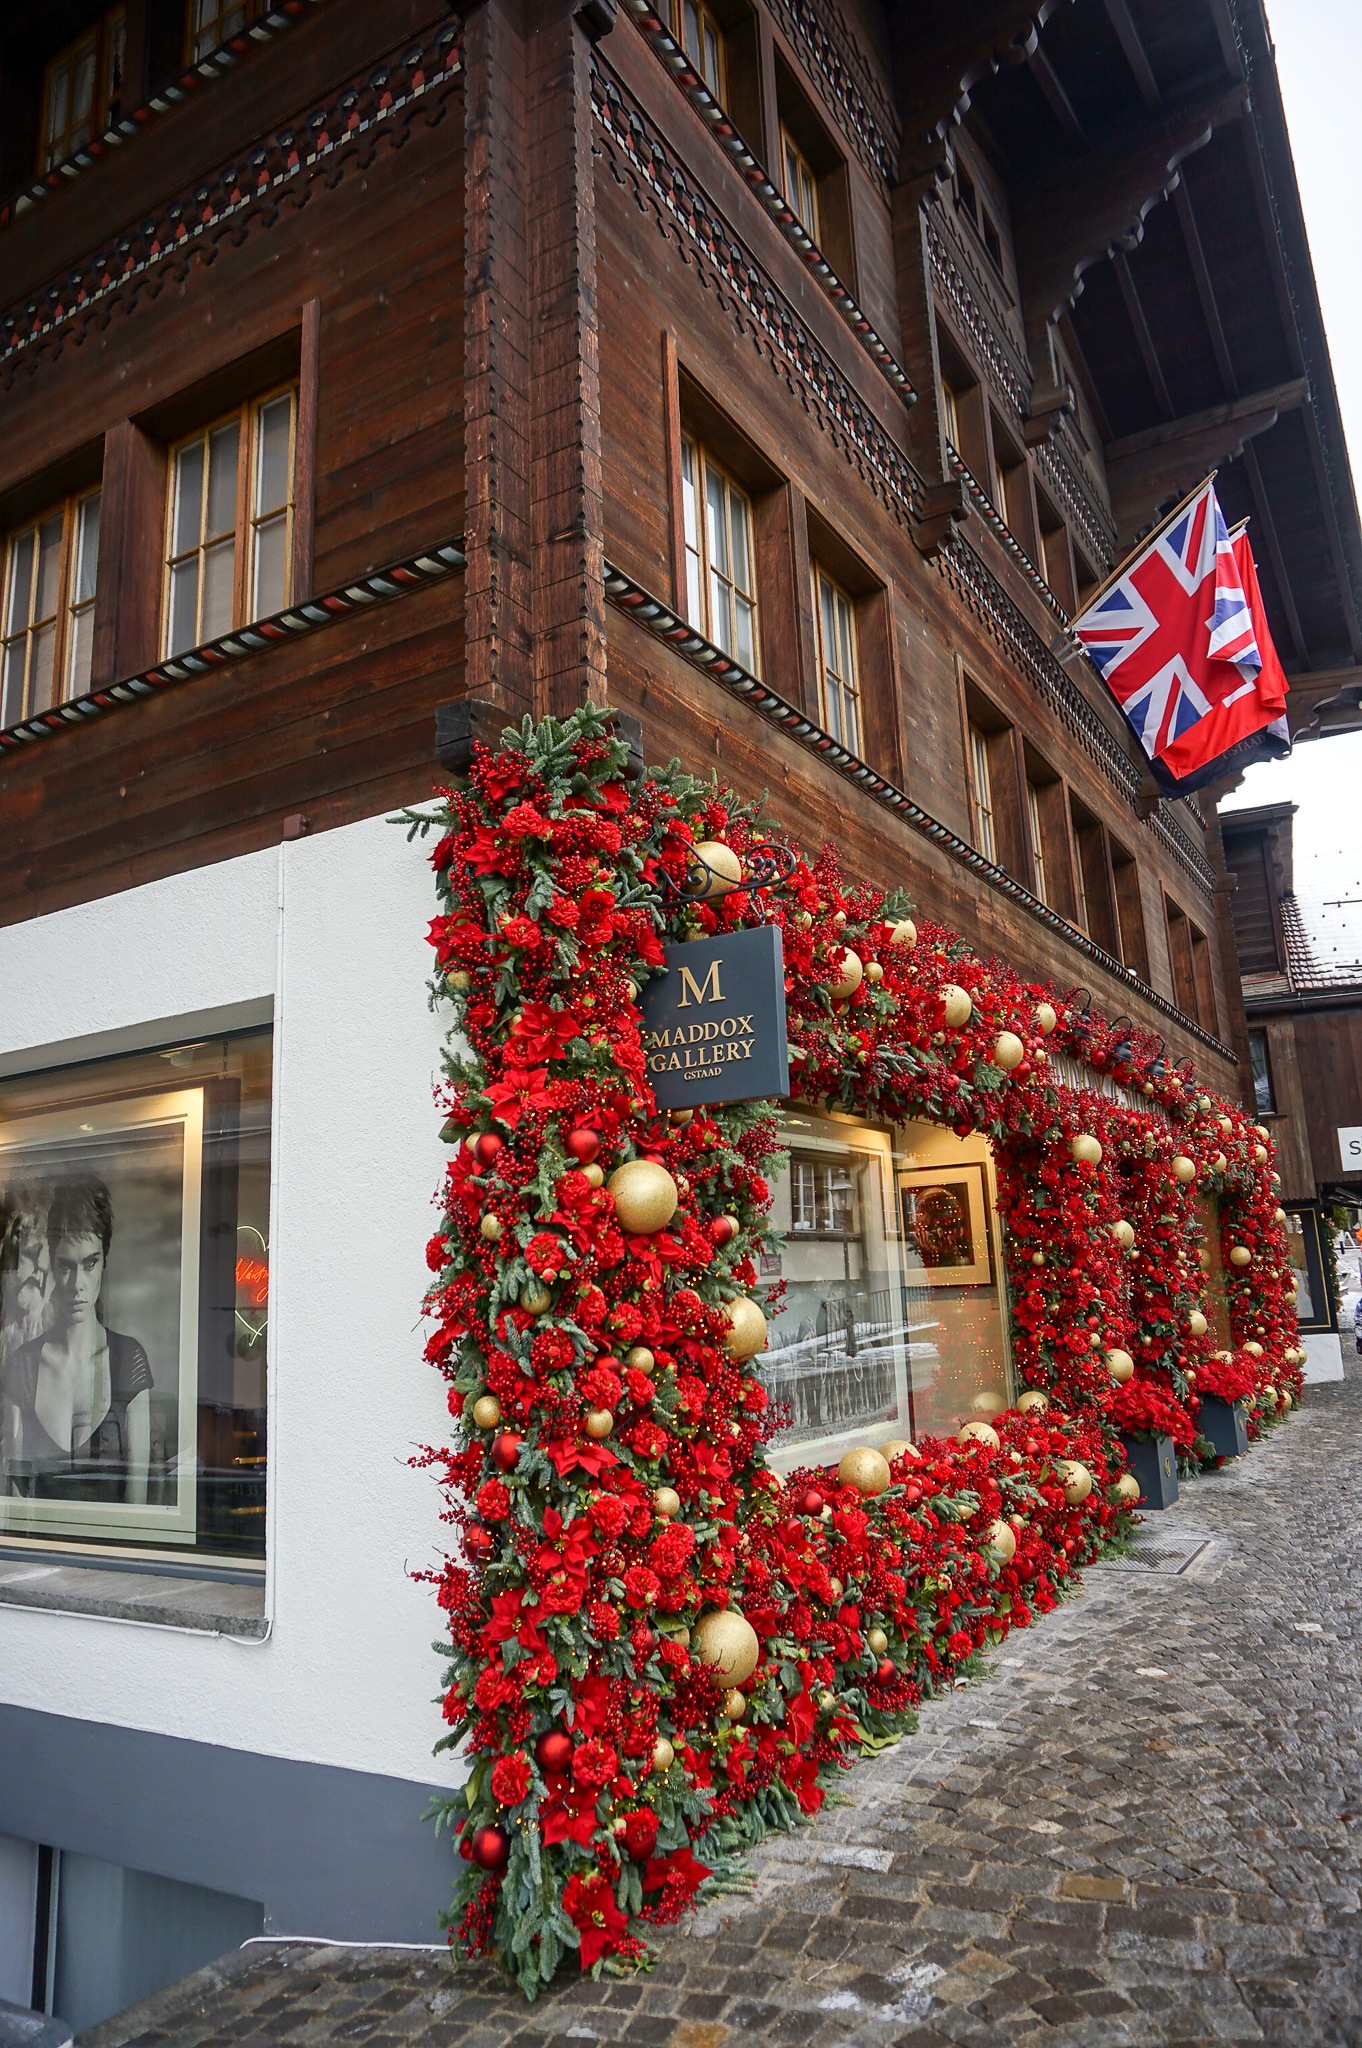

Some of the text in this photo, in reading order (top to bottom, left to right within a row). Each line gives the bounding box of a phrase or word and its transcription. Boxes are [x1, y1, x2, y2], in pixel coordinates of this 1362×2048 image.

[677, 959, 726, 1009] M
[650, 1014, 755, 1049] MADDOX
[650, 1038, 756, 1073] GALLERY
[684, 1067, 722, 1081] GSTAAD
[1349, 1140, 1362, 1155] S
